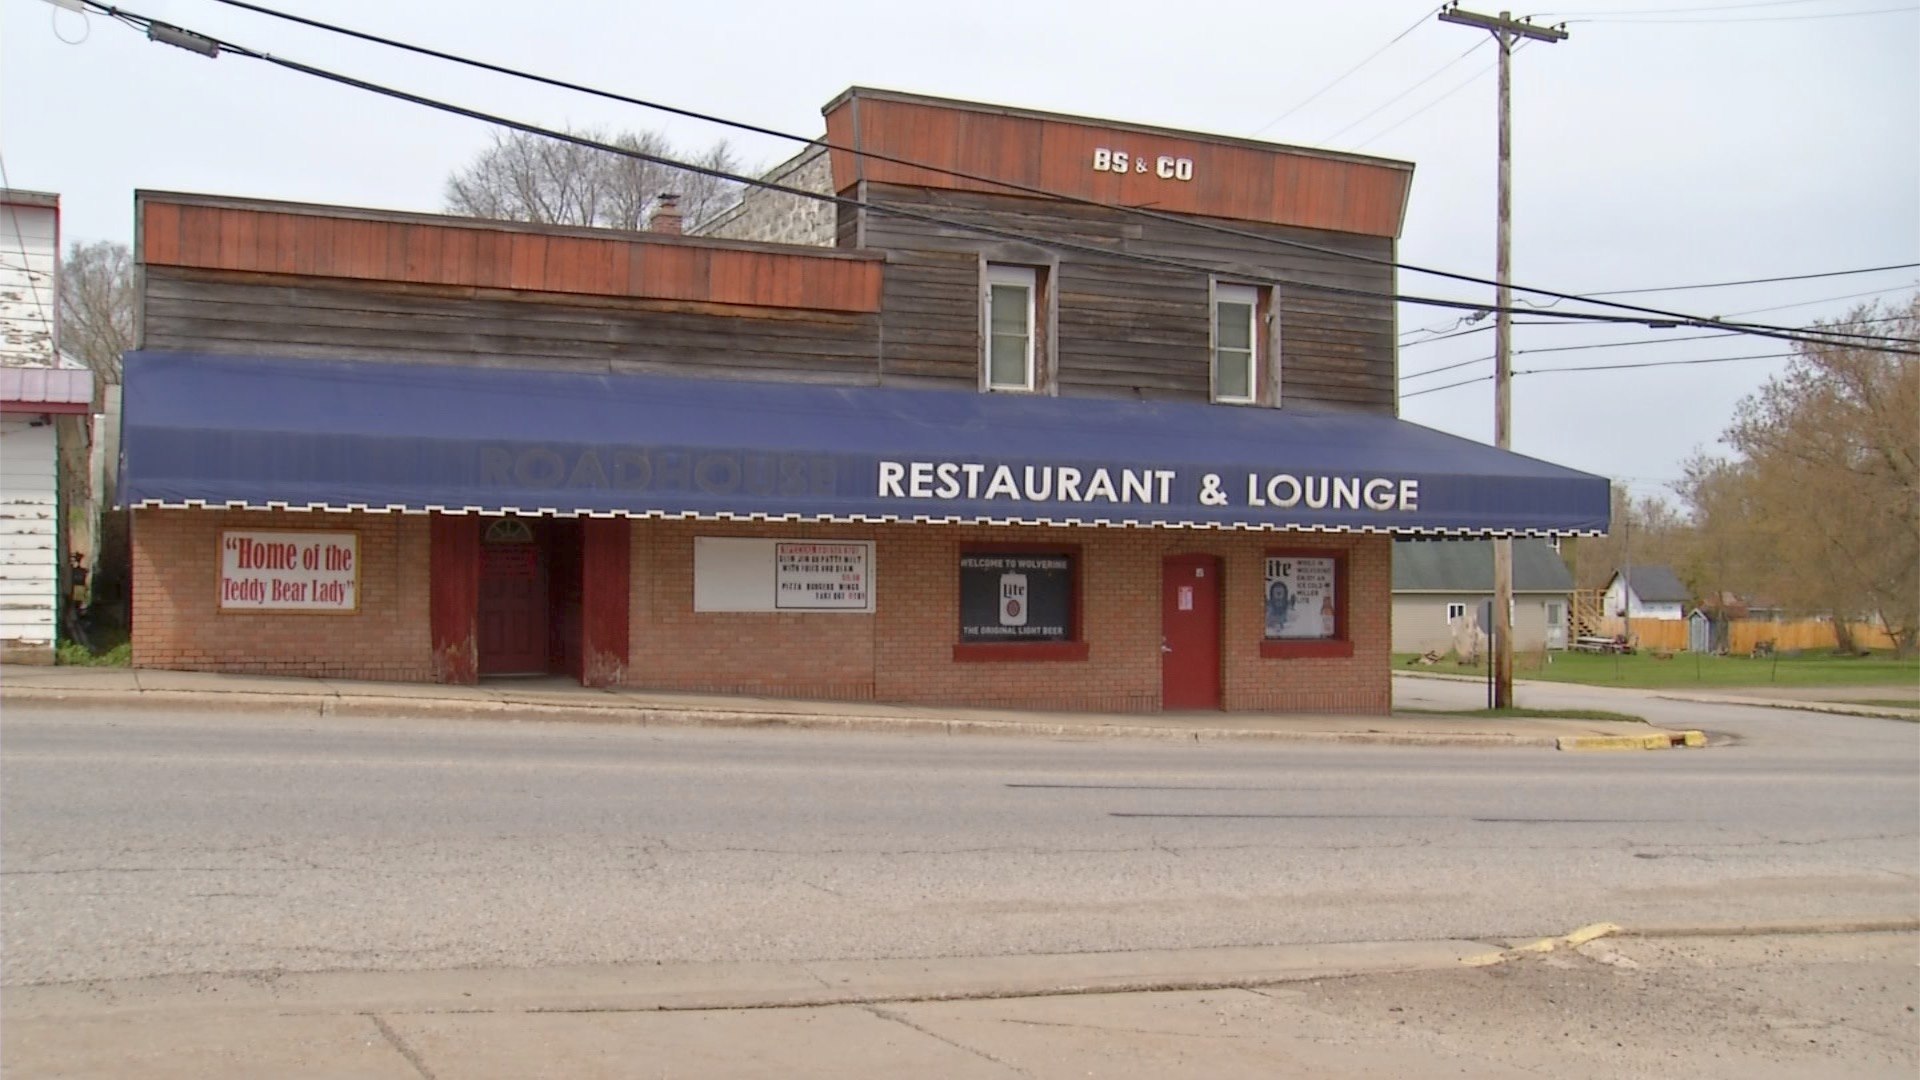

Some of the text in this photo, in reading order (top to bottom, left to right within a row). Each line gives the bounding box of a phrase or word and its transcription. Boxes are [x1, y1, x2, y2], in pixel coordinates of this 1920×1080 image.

[1093, 147, 1193, 181] BS & CO
[877, 461, 1177, 504] RESTAURANT
[1198, 472, 1228, 507] &
[1247, 472, 1420, 512] LOUNGE
[303, 543, 321, 571] of
[325, 544, 352, 571] the
[960, 558, 1067, 569] WELCOME TO WOLVERINE
[1266, 560, 1292, 579] ite
[223, 577, 267, 604] Teddy
[271, 578, 308, 602] Bear
[1003, 583, 1025, 599] Lite
[963, 626, 1063, 635] THE ORIGINAL LIGHT BEER
